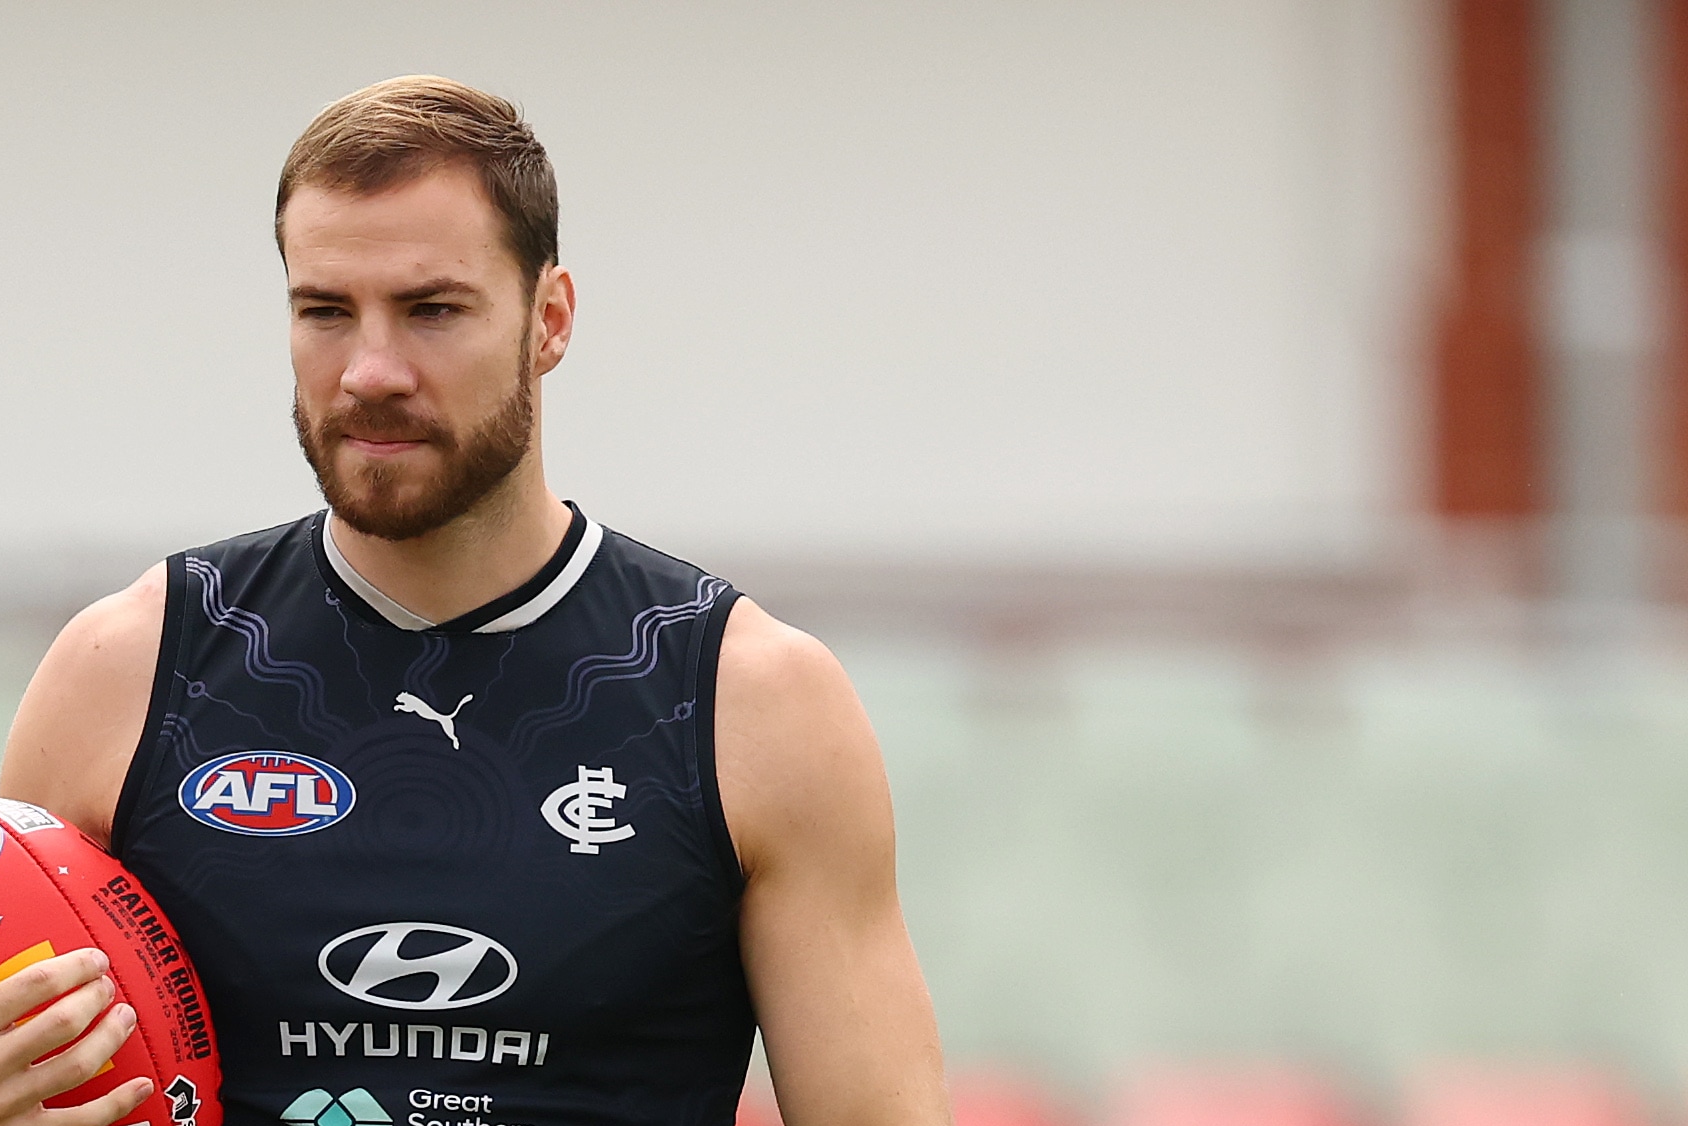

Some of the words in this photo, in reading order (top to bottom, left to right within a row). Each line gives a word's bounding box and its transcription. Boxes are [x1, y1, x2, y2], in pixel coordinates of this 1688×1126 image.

[192, 772, 338, 817] AFL
[107, 875, 179, 966] GATHER
[168, 966, 212, 1060] ROUND
[279, 1021, 550, 1066] HYUNDAI
[408, 1088, 494, 1114] Great
